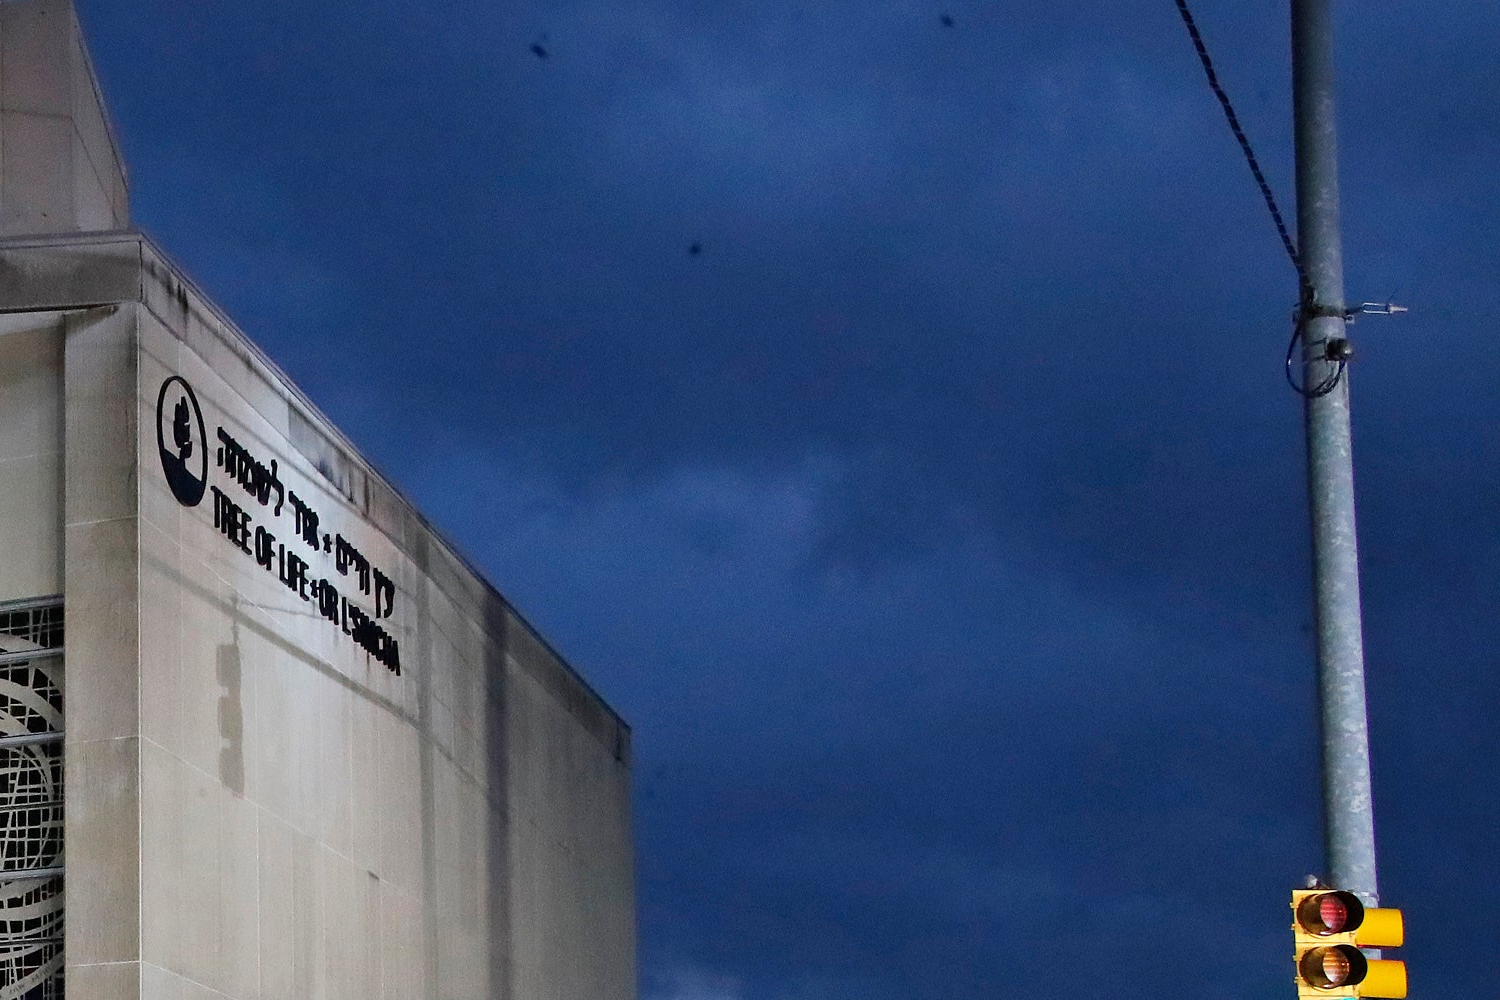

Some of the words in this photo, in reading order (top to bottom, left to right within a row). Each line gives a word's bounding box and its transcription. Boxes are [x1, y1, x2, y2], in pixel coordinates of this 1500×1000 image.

[211, 486, 252, 556] TREE
[255, 526, 276, 571] OF
[279, 544, 310, 601] LIFE
[319, 579, 339, 625] OR
